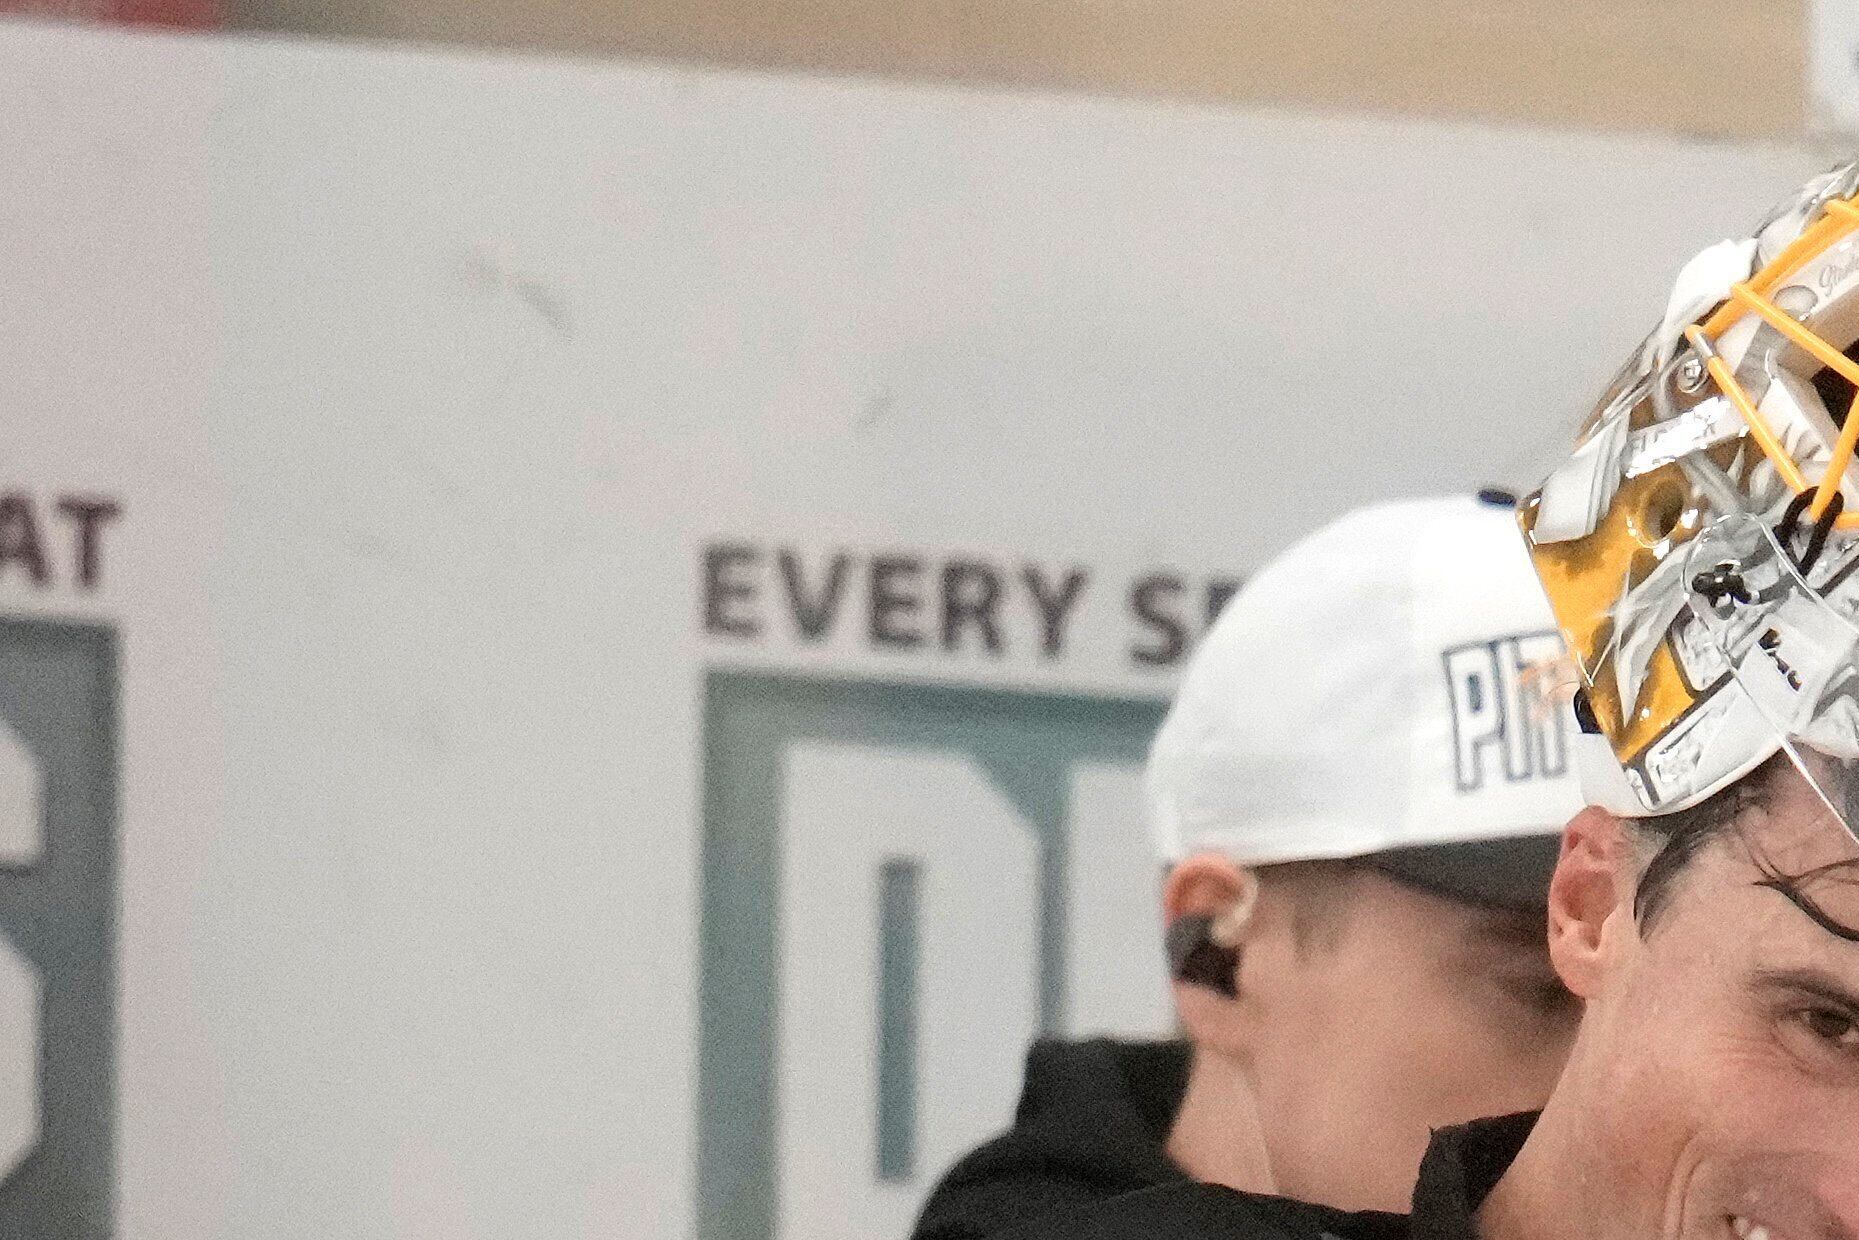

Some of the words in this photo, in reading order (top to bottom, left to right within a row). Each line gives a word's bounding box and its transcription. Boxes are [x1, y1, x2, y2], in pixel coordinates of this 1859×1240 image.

[0, 490, 121, 590] AT
[702, 540, 1088, 660] EVERY
[1130, 570, 1246, 667] S
[1441, 629, 1571, 792] PIT
